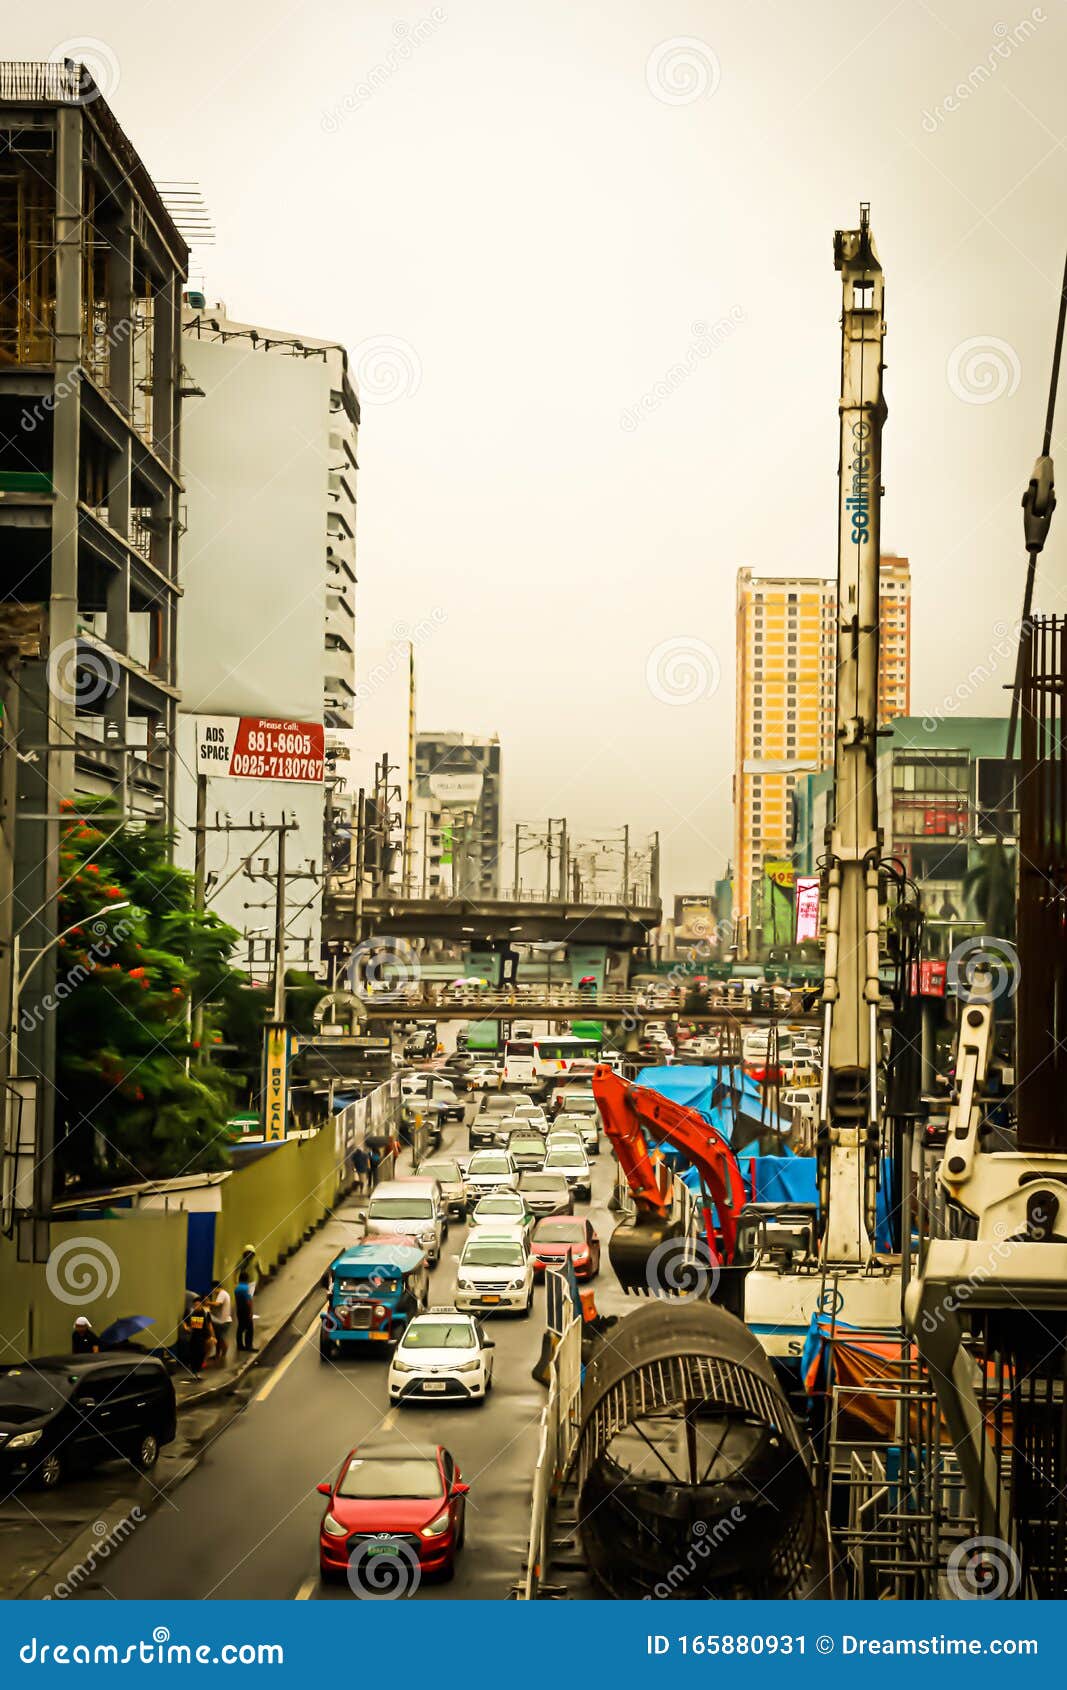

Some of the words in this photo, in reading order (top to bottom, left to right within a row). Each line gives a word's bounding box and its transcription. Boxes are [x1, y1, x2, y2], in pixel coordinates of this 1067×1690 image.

[205, 727, 224, 743] ADS
[259, 720, 282, 730] Please
[200, 744, 229, 761] SPACE
[248, 731, 311, 756] 881-8605
[233, 754, 323, 779] 0925-7130767
[271, 1067, 281, 1096] BOY
